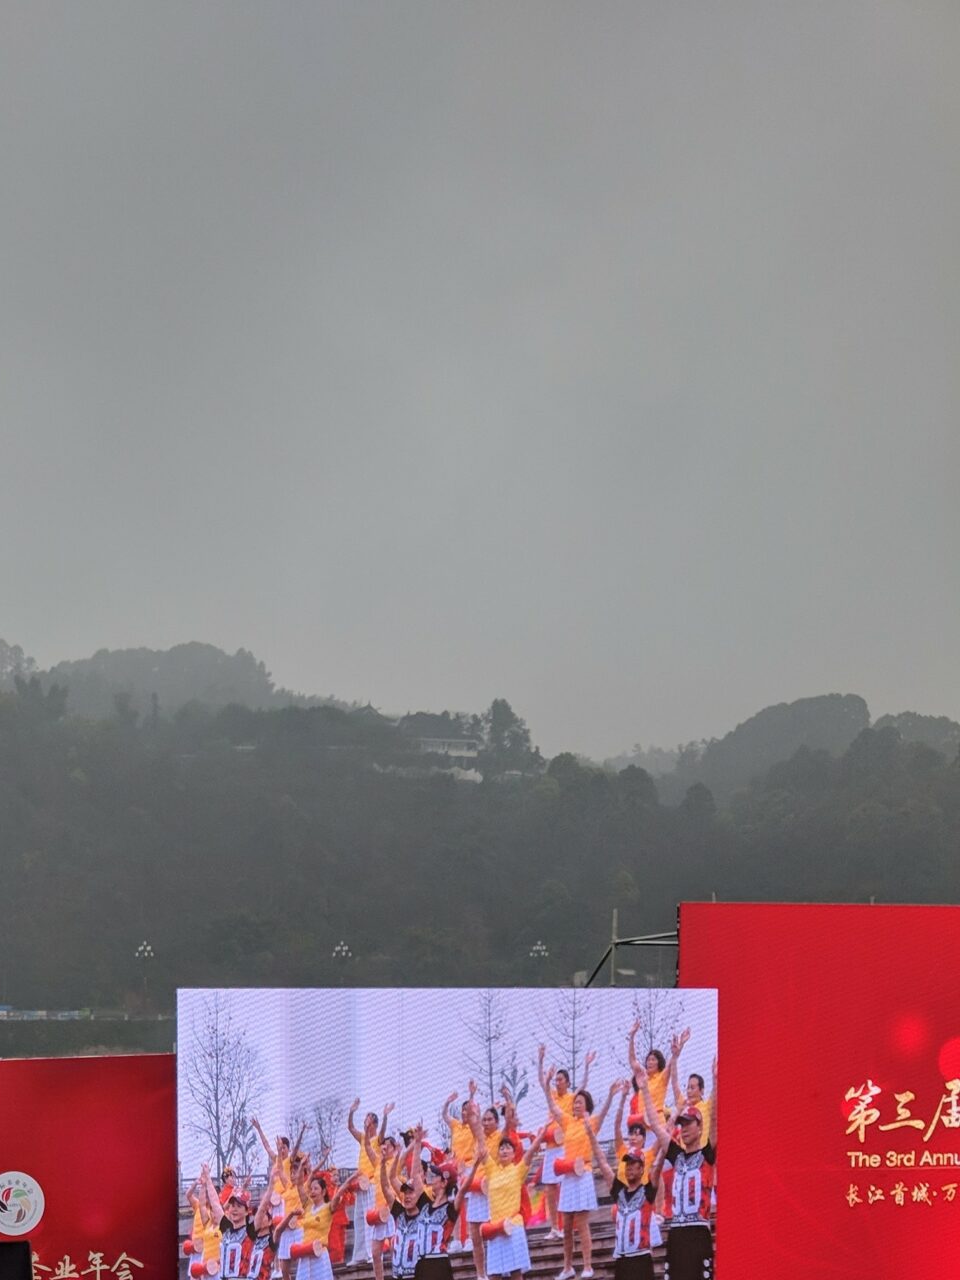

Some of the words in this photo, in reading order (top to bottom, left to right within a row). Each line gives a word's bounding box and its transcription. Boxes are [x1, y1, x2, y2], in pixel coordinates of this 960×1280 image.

[844, 1079, 960, 1142] 第三届
[847, 1151, 881, 1167] The
[885, 1151, 915, 1167] 3rd
